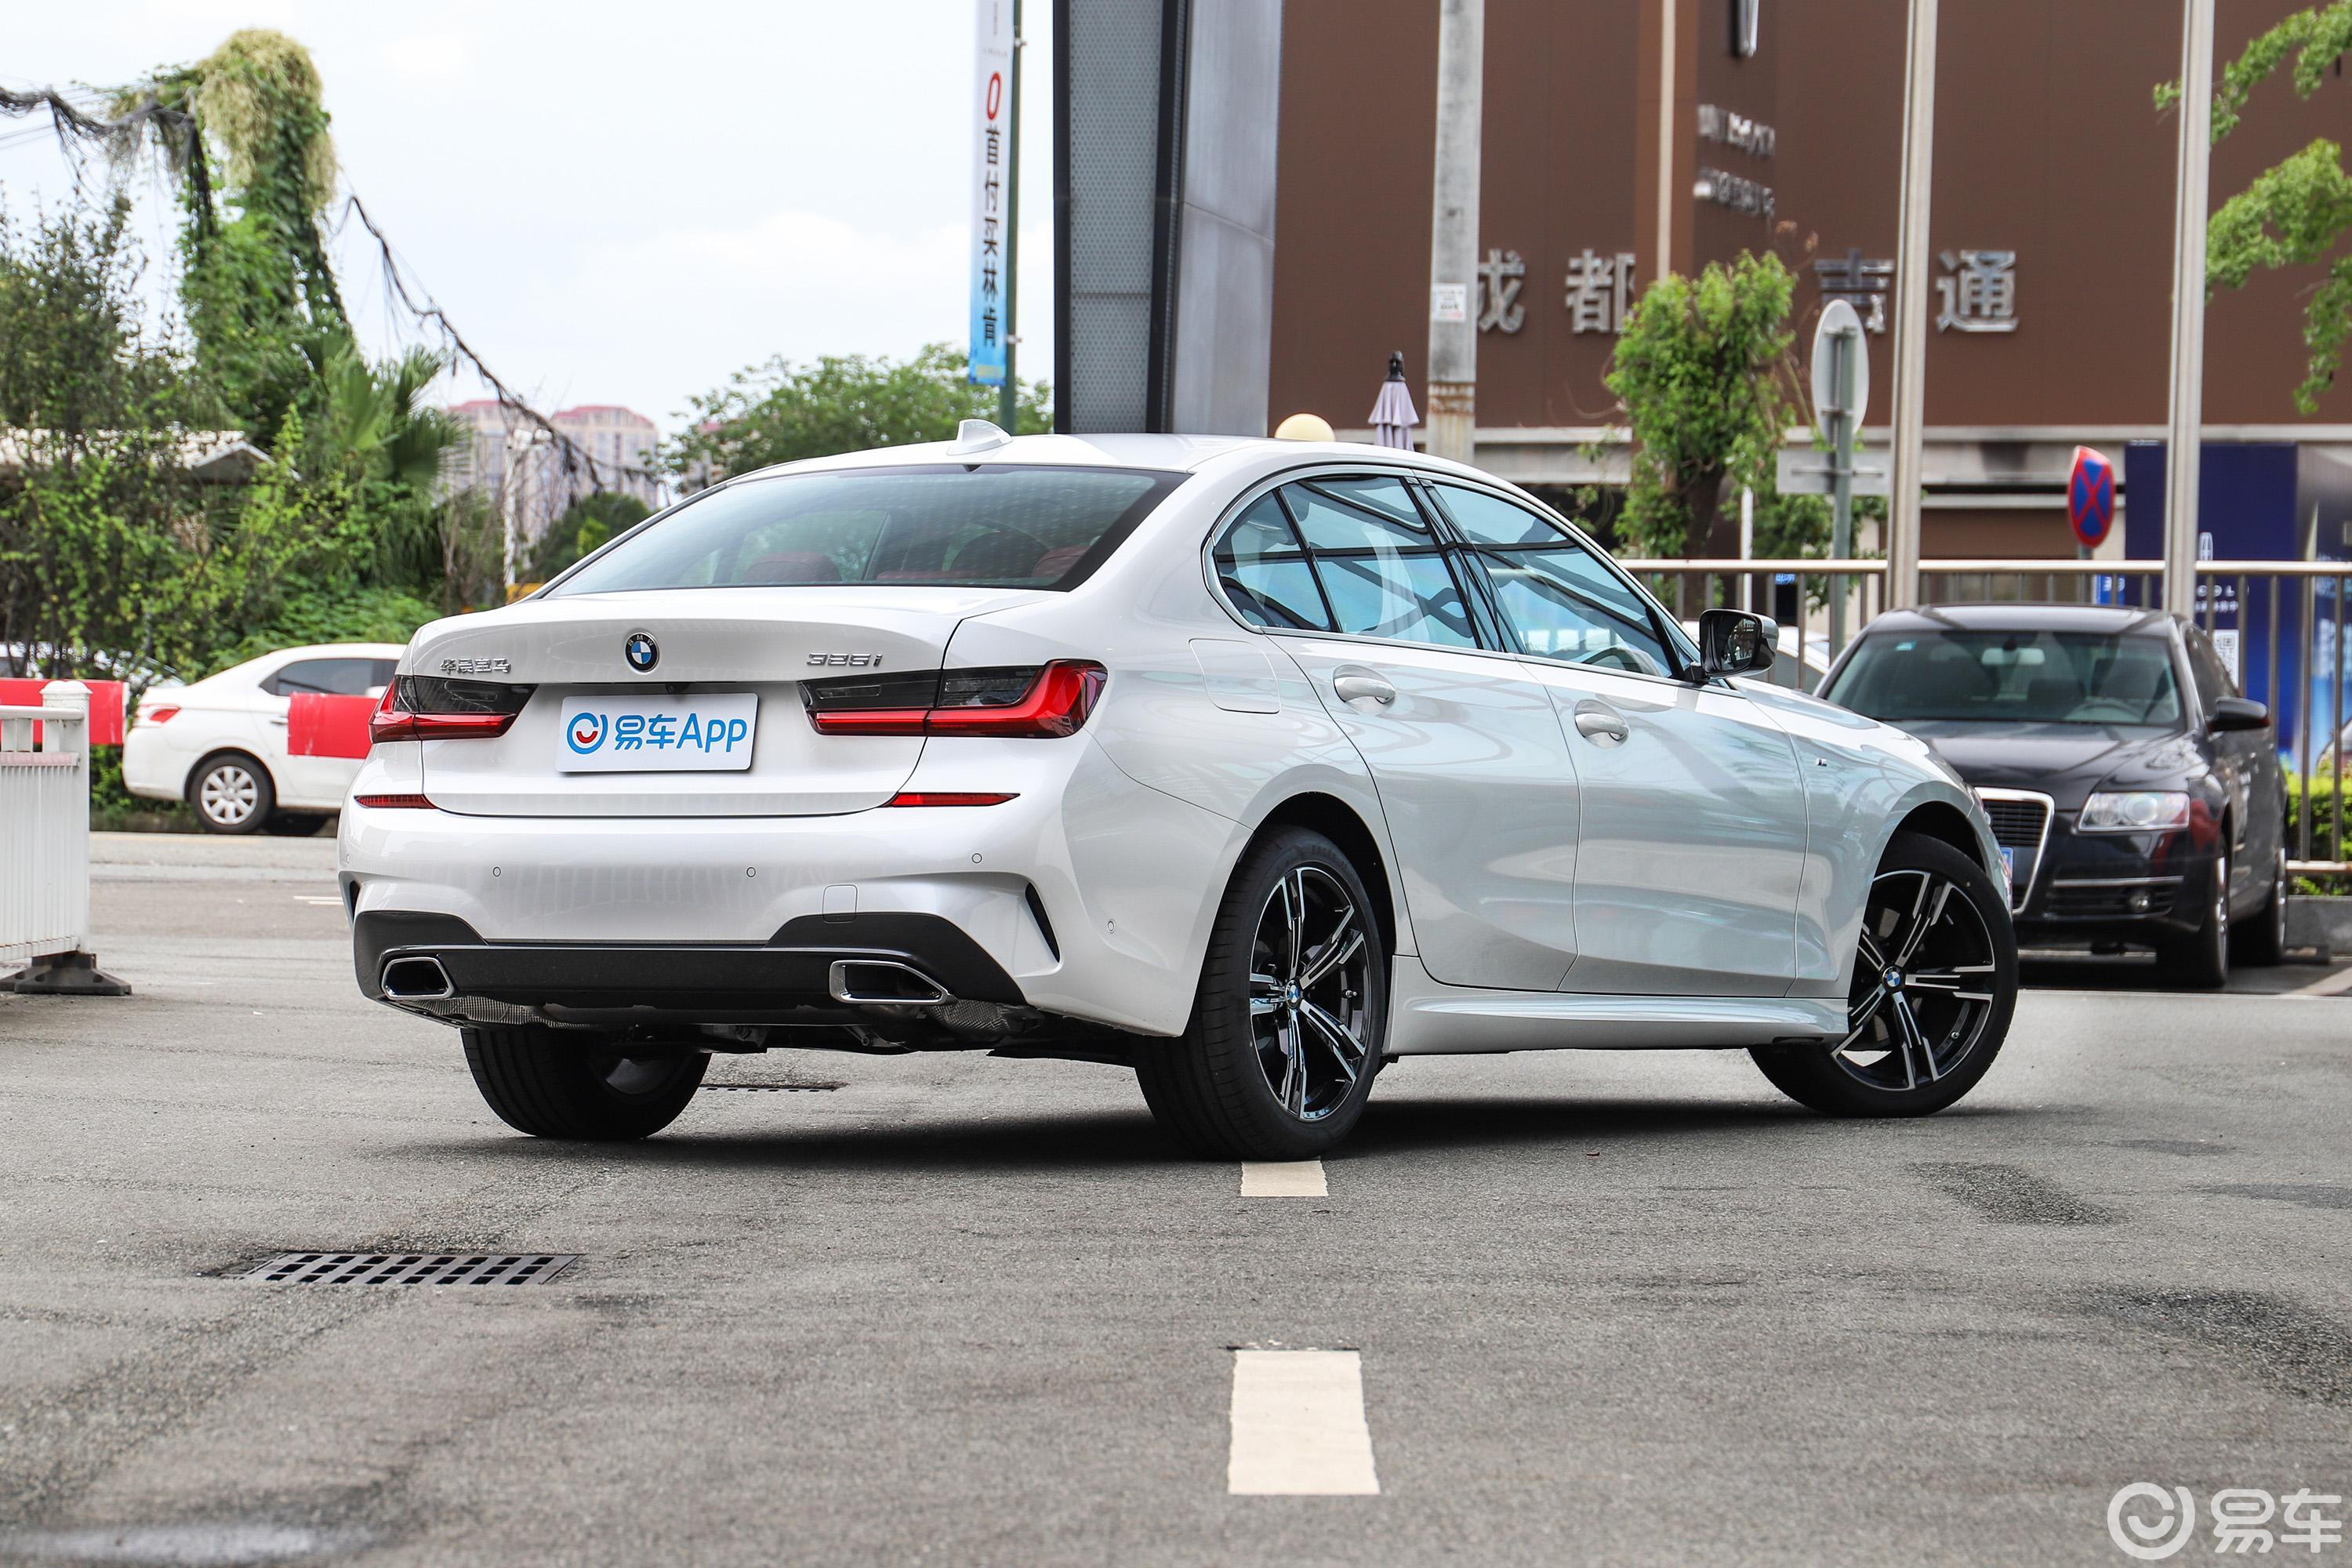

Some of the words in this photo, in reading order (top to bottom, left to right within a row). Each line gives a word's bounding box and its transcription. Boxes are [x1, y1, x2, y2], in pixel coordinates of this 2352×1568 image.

[628, 634, 654, 646] BMW
[439, 658, 511, 674] 华晨宝马
[807, 652, 884, 666] 325i
[615, 713, 748, 753] 易车App
